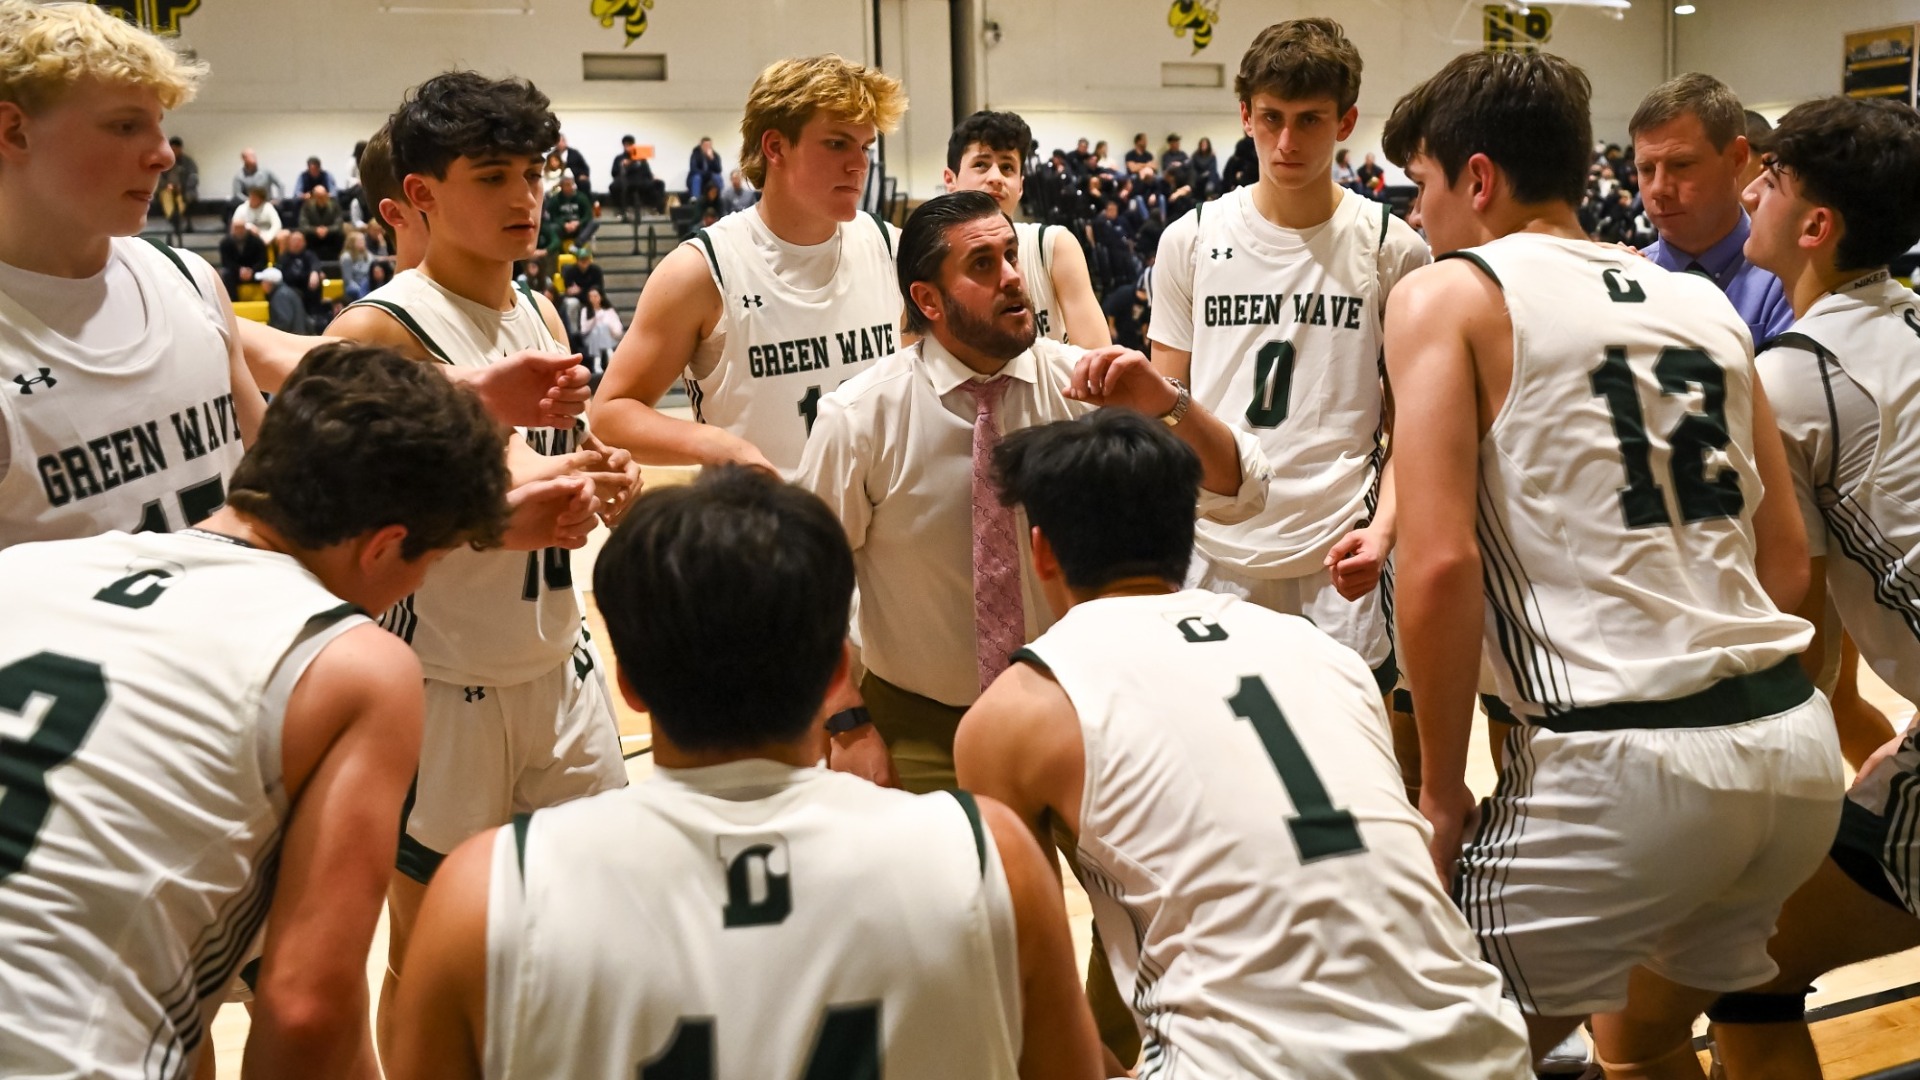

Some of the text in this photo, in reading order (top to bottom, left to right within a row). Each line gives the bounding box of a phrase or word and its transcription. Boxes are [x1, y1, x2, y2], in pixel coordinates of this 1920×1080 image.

[748, 323, 895, 378] GREEN WAVE
[1204, 292, 1363, 330] GREEN WAVE
[1245, 338, 1296, 429] 0
[36, 420, 168, 508] GREEN
[1587, 344, 1746, 531] 12
[1226, 674, 1368, 865] 1
